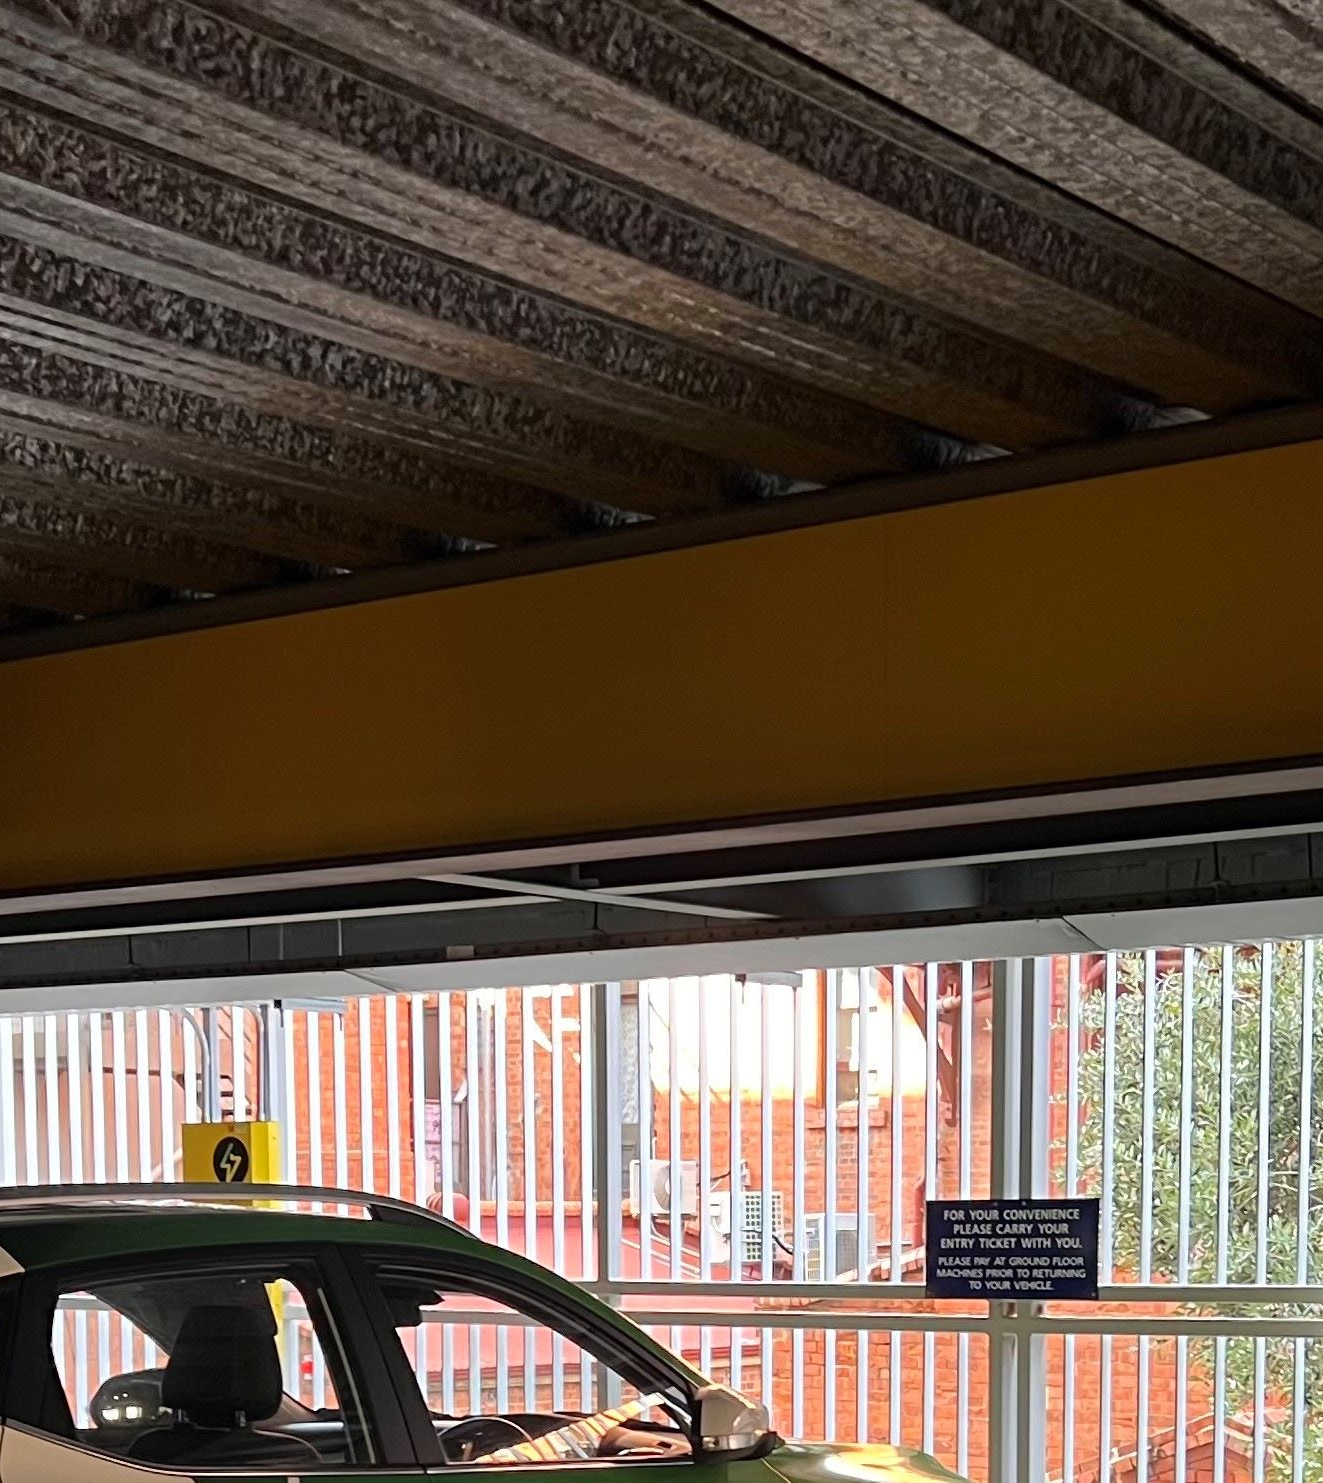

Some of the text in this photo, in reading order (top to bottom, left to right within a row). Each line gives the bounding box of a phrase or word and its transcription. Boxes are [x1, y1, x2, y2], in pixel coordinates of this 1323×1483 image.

[943, 1209, 1079, 1221] FOR YOUR CONVENIENCE
[953, 1223, 1069, 1234] PLEASE CARRY YOUR
[940, 1238, 1082, 1249] ENTRY TICKET WITH YOU.
[938, 1257, 1084, 1266] PLEASE PAY AT GROUND FLOOR
[936, 1269, 1086, 1278] MACHINES PRIOR TO RETURNING
[968, 1281, 981, 1290] TO
[985, 1281, 1011, 1290] YOUR
